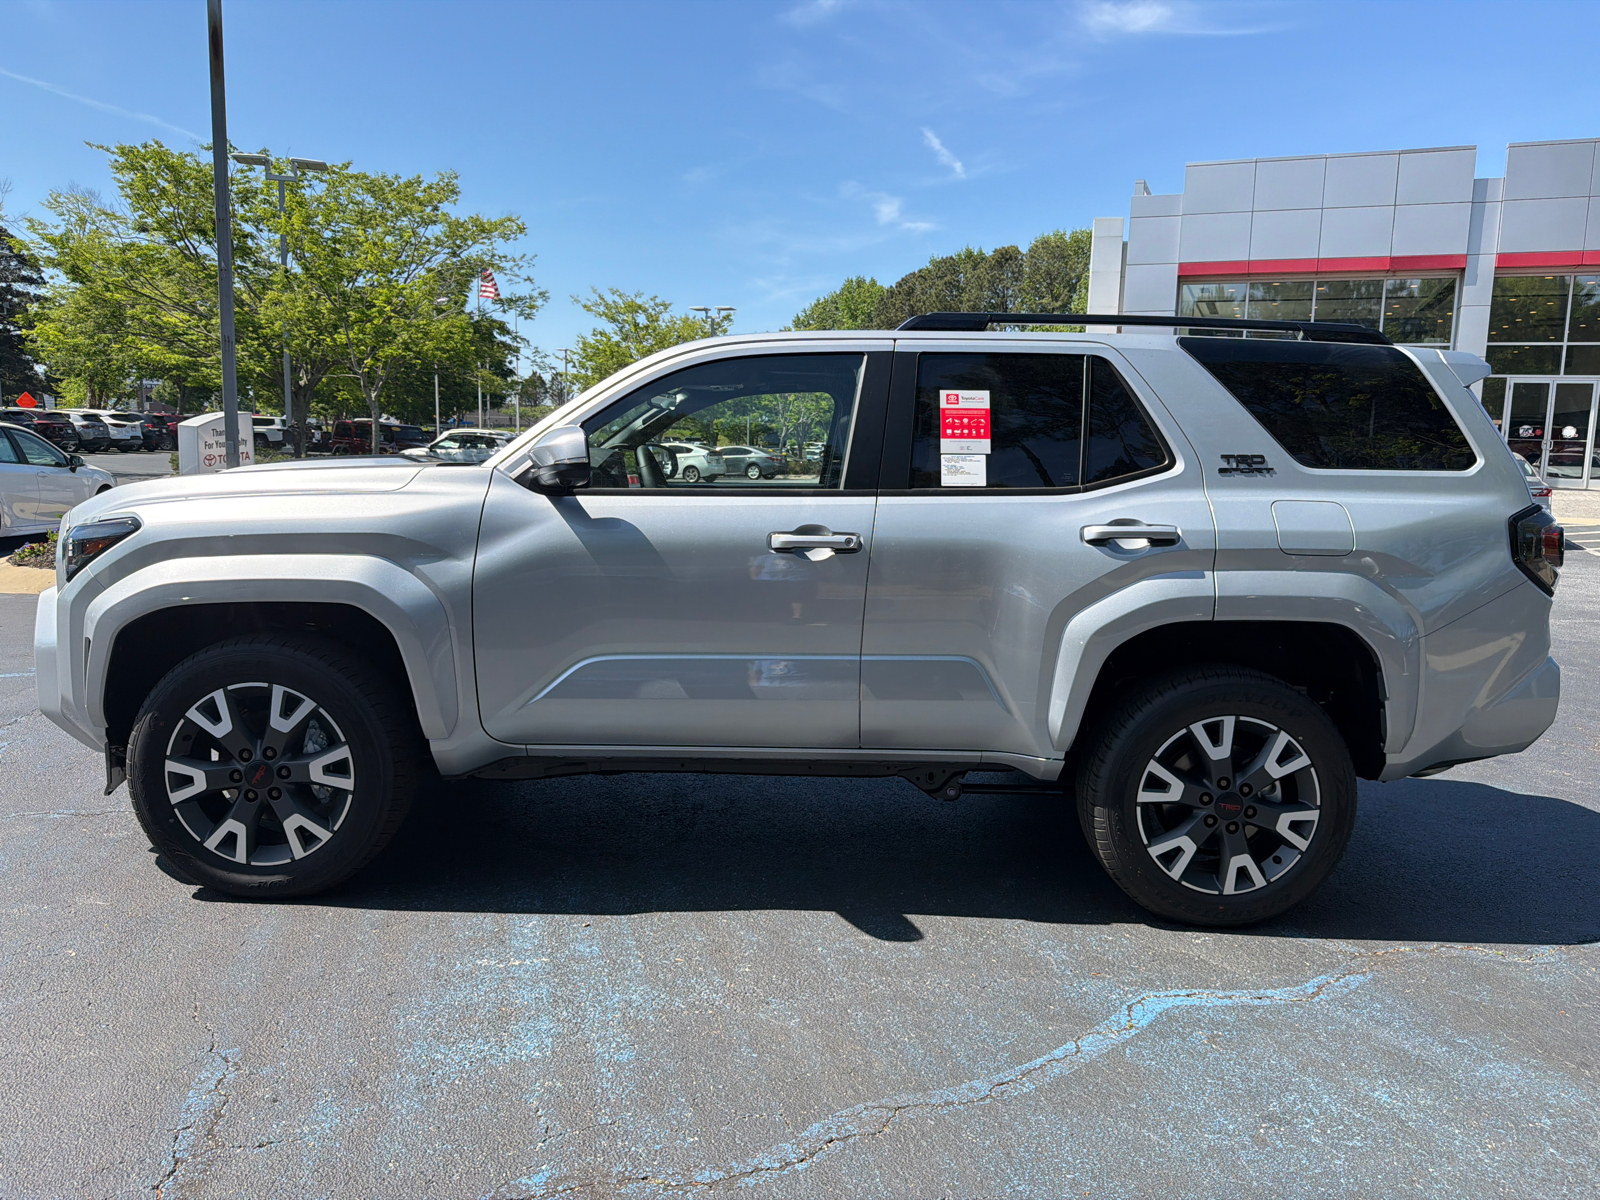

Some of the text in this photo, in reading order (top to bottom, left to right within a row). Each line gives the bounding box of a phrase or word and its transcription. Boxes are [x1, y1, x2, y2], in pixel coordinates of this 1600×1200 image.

[211, 428, 225, 437] Than
[204, 440, 214, 450] For
[214, 439, 226, 449] You
[217, 451, 251, 465] TOTA
[1220, 454, 1266, 468] TRD
[1217, 467, 1276, 475] SPORT
[1218, 802, 1241, 811] TRD
